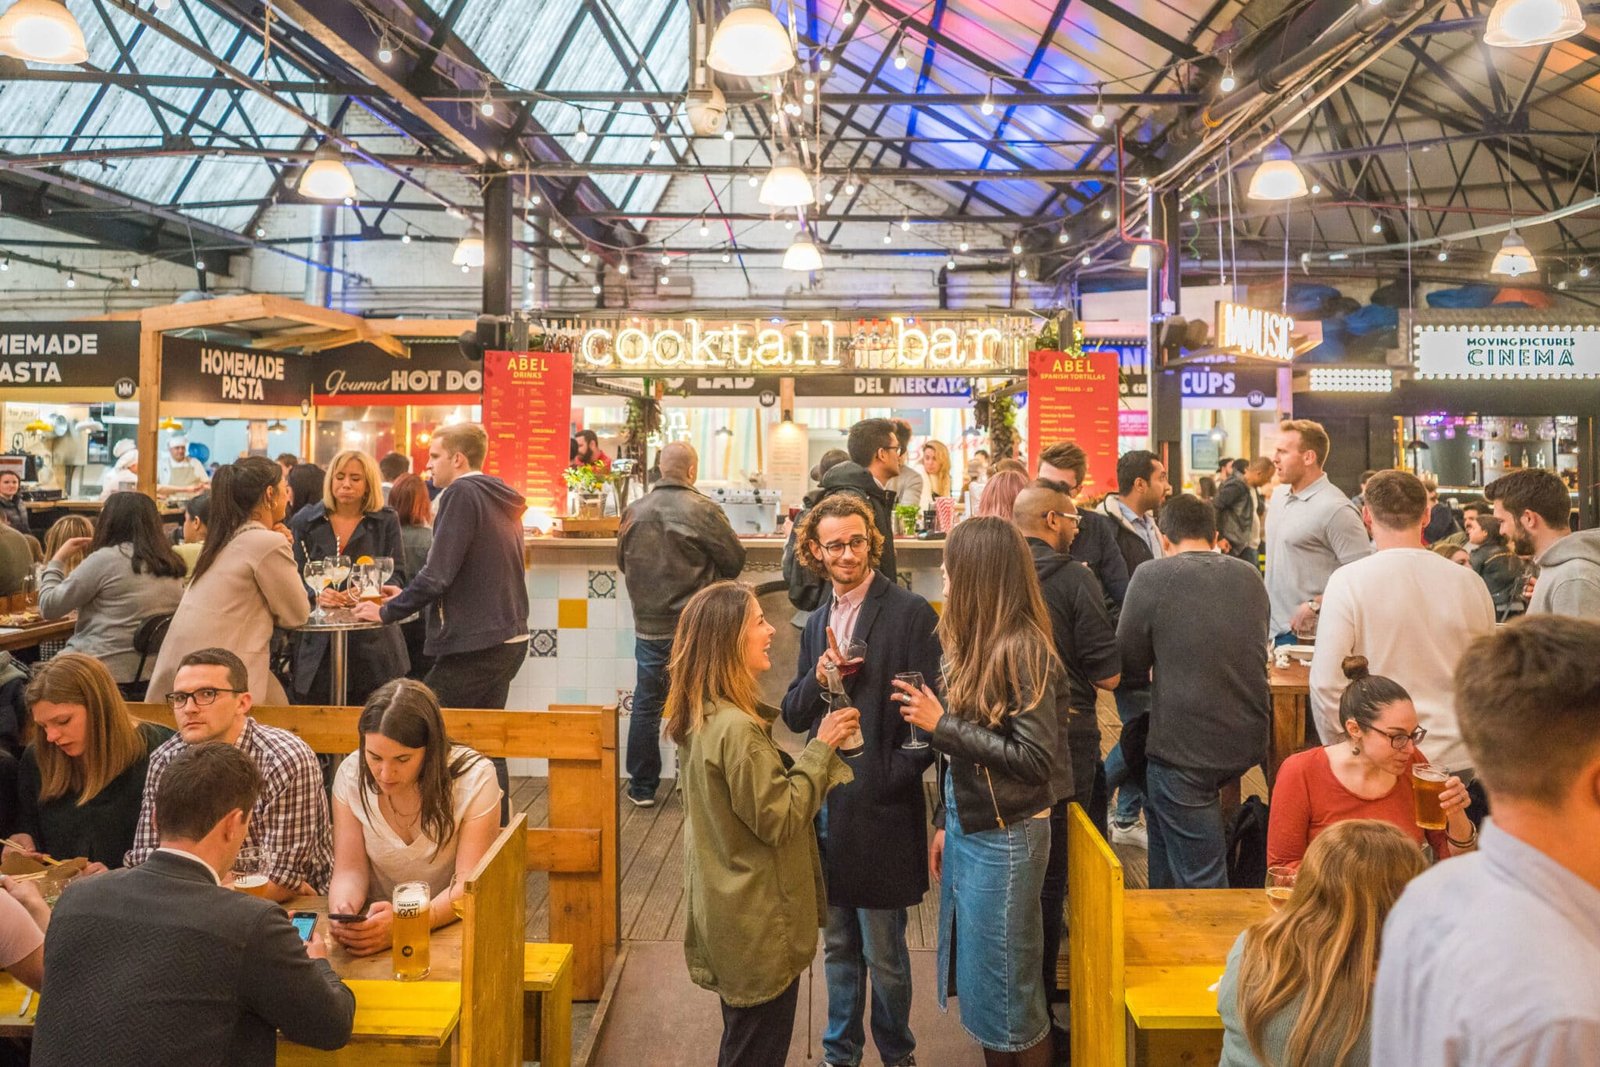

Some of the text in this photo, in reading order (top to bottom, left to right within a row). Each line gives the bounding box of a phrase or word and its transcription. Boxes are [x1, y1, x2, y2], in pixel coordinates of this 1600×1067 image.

[583, 317, 1002, 366] cocktail bar
[1467, 338, 1575, 346] MOVING PICTURES
[200, 348, 285, 381] HOMEMADE
[507, 357, 549, 371] ABEL
[1052, 359, 1095, 373] ABEL
[1467, 349, 1575, 366] CINEMA
[0, 361, 62, 383] ASTA
[513, 371, 542, 379] DRINKS
[1070, 373, 1106, 381] TORTILLAS
[222, 375, 264, 400] PASTA
[325, 369, 482, 397] Gourmet HOT DO
[854, 377, 970, 394] DEL MERCATO
[1181, 371, 1236, 395] CUPS
